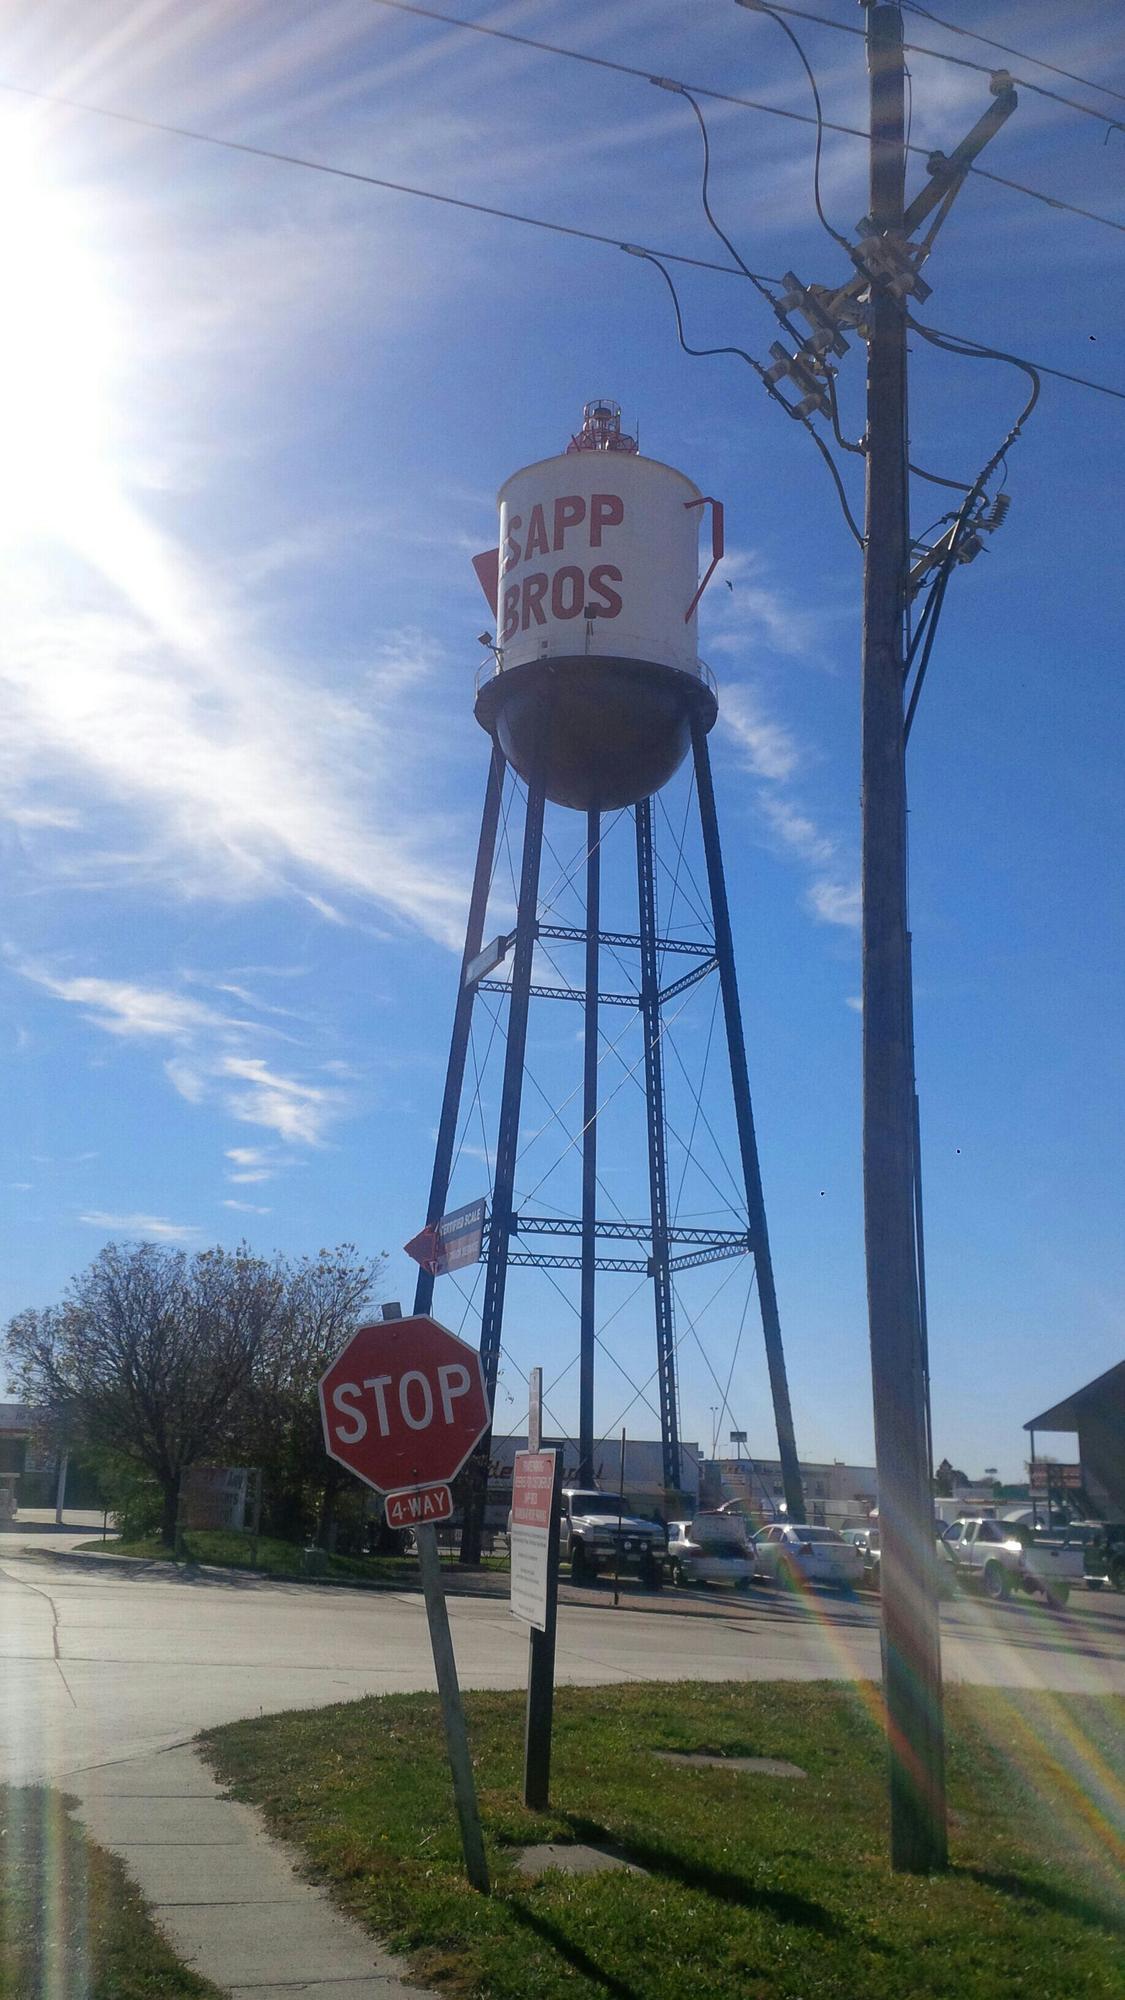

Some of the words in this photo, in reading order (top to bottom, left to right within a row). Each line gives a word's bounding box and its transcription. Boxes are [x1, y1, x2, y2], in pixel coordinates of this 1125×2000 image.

[502, 494, 624, 576] SAPP
[501, 564, 623, 642] BROS
[464, 1207, 481, 1227] SCALE
[332, 1363, 471, 1444] STOP
[391, 1491, 445, 1520] 4-WAY
